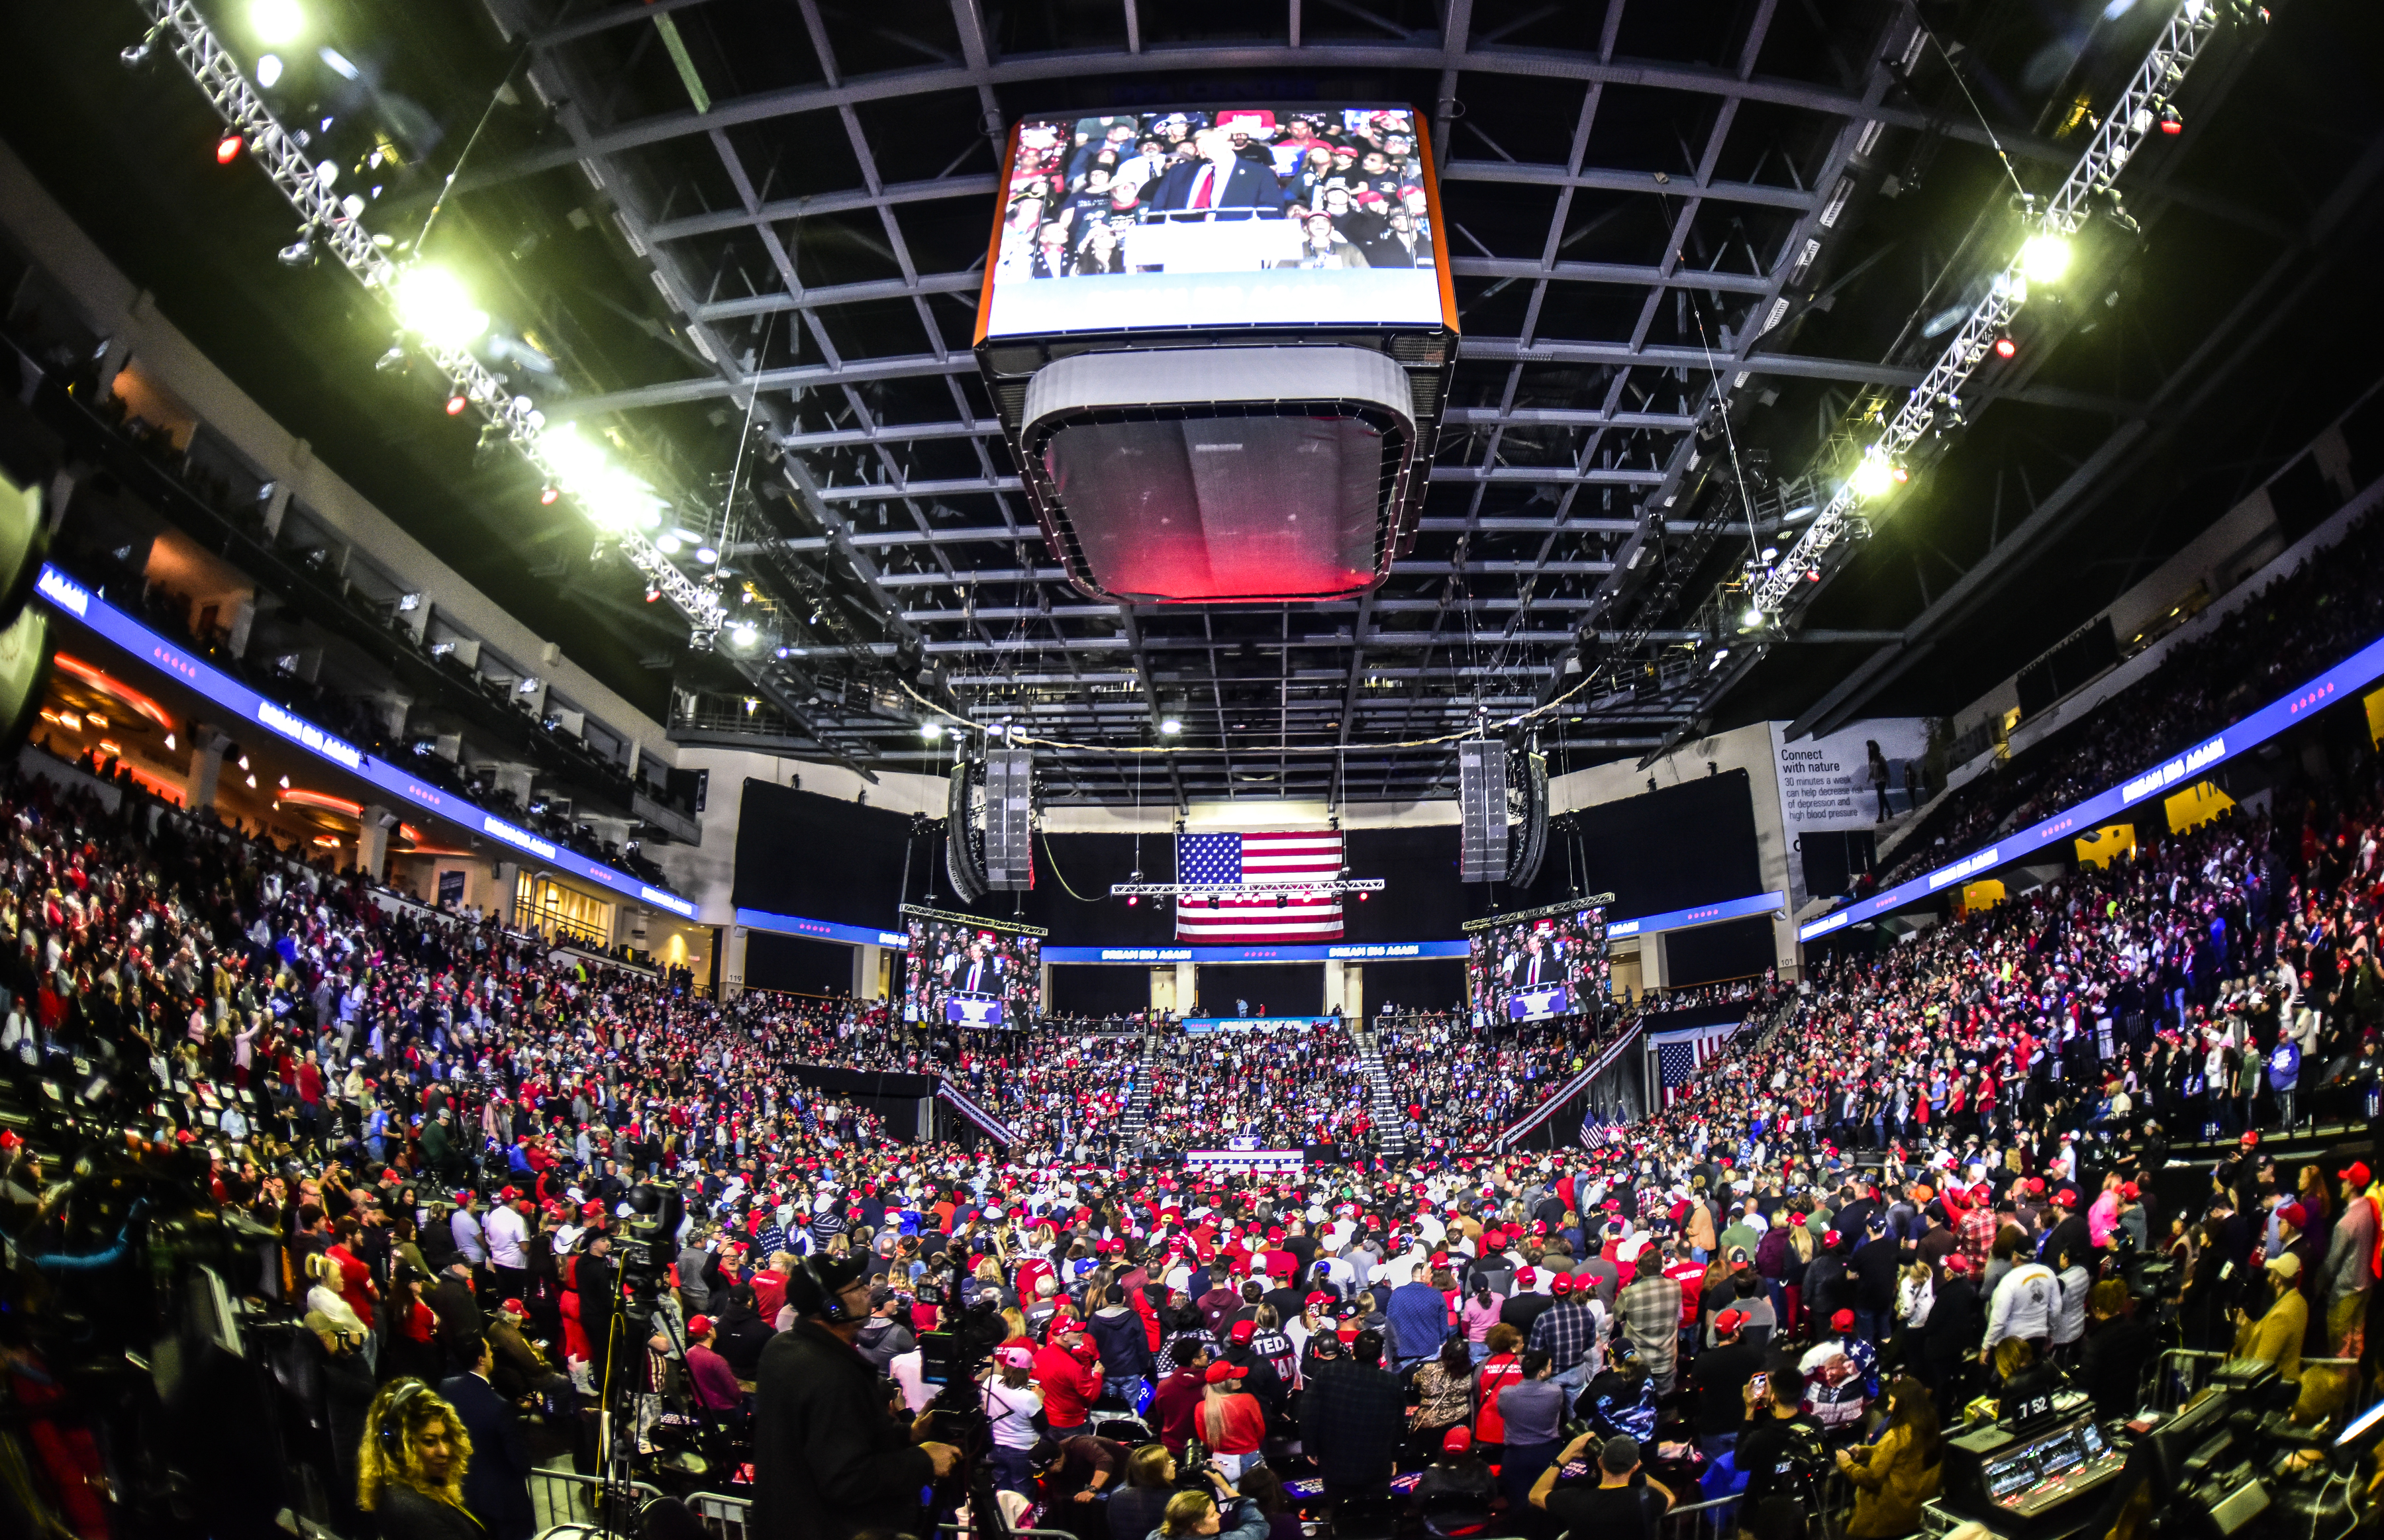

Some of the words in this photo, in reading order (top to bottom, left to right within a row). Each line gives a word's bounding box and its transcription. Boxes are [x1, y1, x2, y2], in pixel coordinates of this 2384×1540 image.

[1781, 749, 1822, 761] Connect
[1783, 762, 1805, 773] with
[1809, 762, 1840, 771] nature
[1785, 777, 1794, 787] 30
[1797, 776, 1824, 785] minutes
[1834, 775, 1851, 784] week
[1787, 789, 1800, 797] can
[1802, 787, 1817, 798] help
[1819, 786, 1850, 796] decrease
[1788, 799, 1795, 808] of
[1797, 798, 1835, 810] depression
[1838, 797, 1850, 806] and
[1789, 811, 1805, 821] high
[1807, 810, 1826, 819] blood
[1828, 810, 1858, 819] pressure
[1102, 949, 1138, 959] DREAM
[1158, 949, 1191, 959] AGAIN
[1329, 947, 1366, 957] DREAM
[1386, 945, 1418, 955] AGAIN
